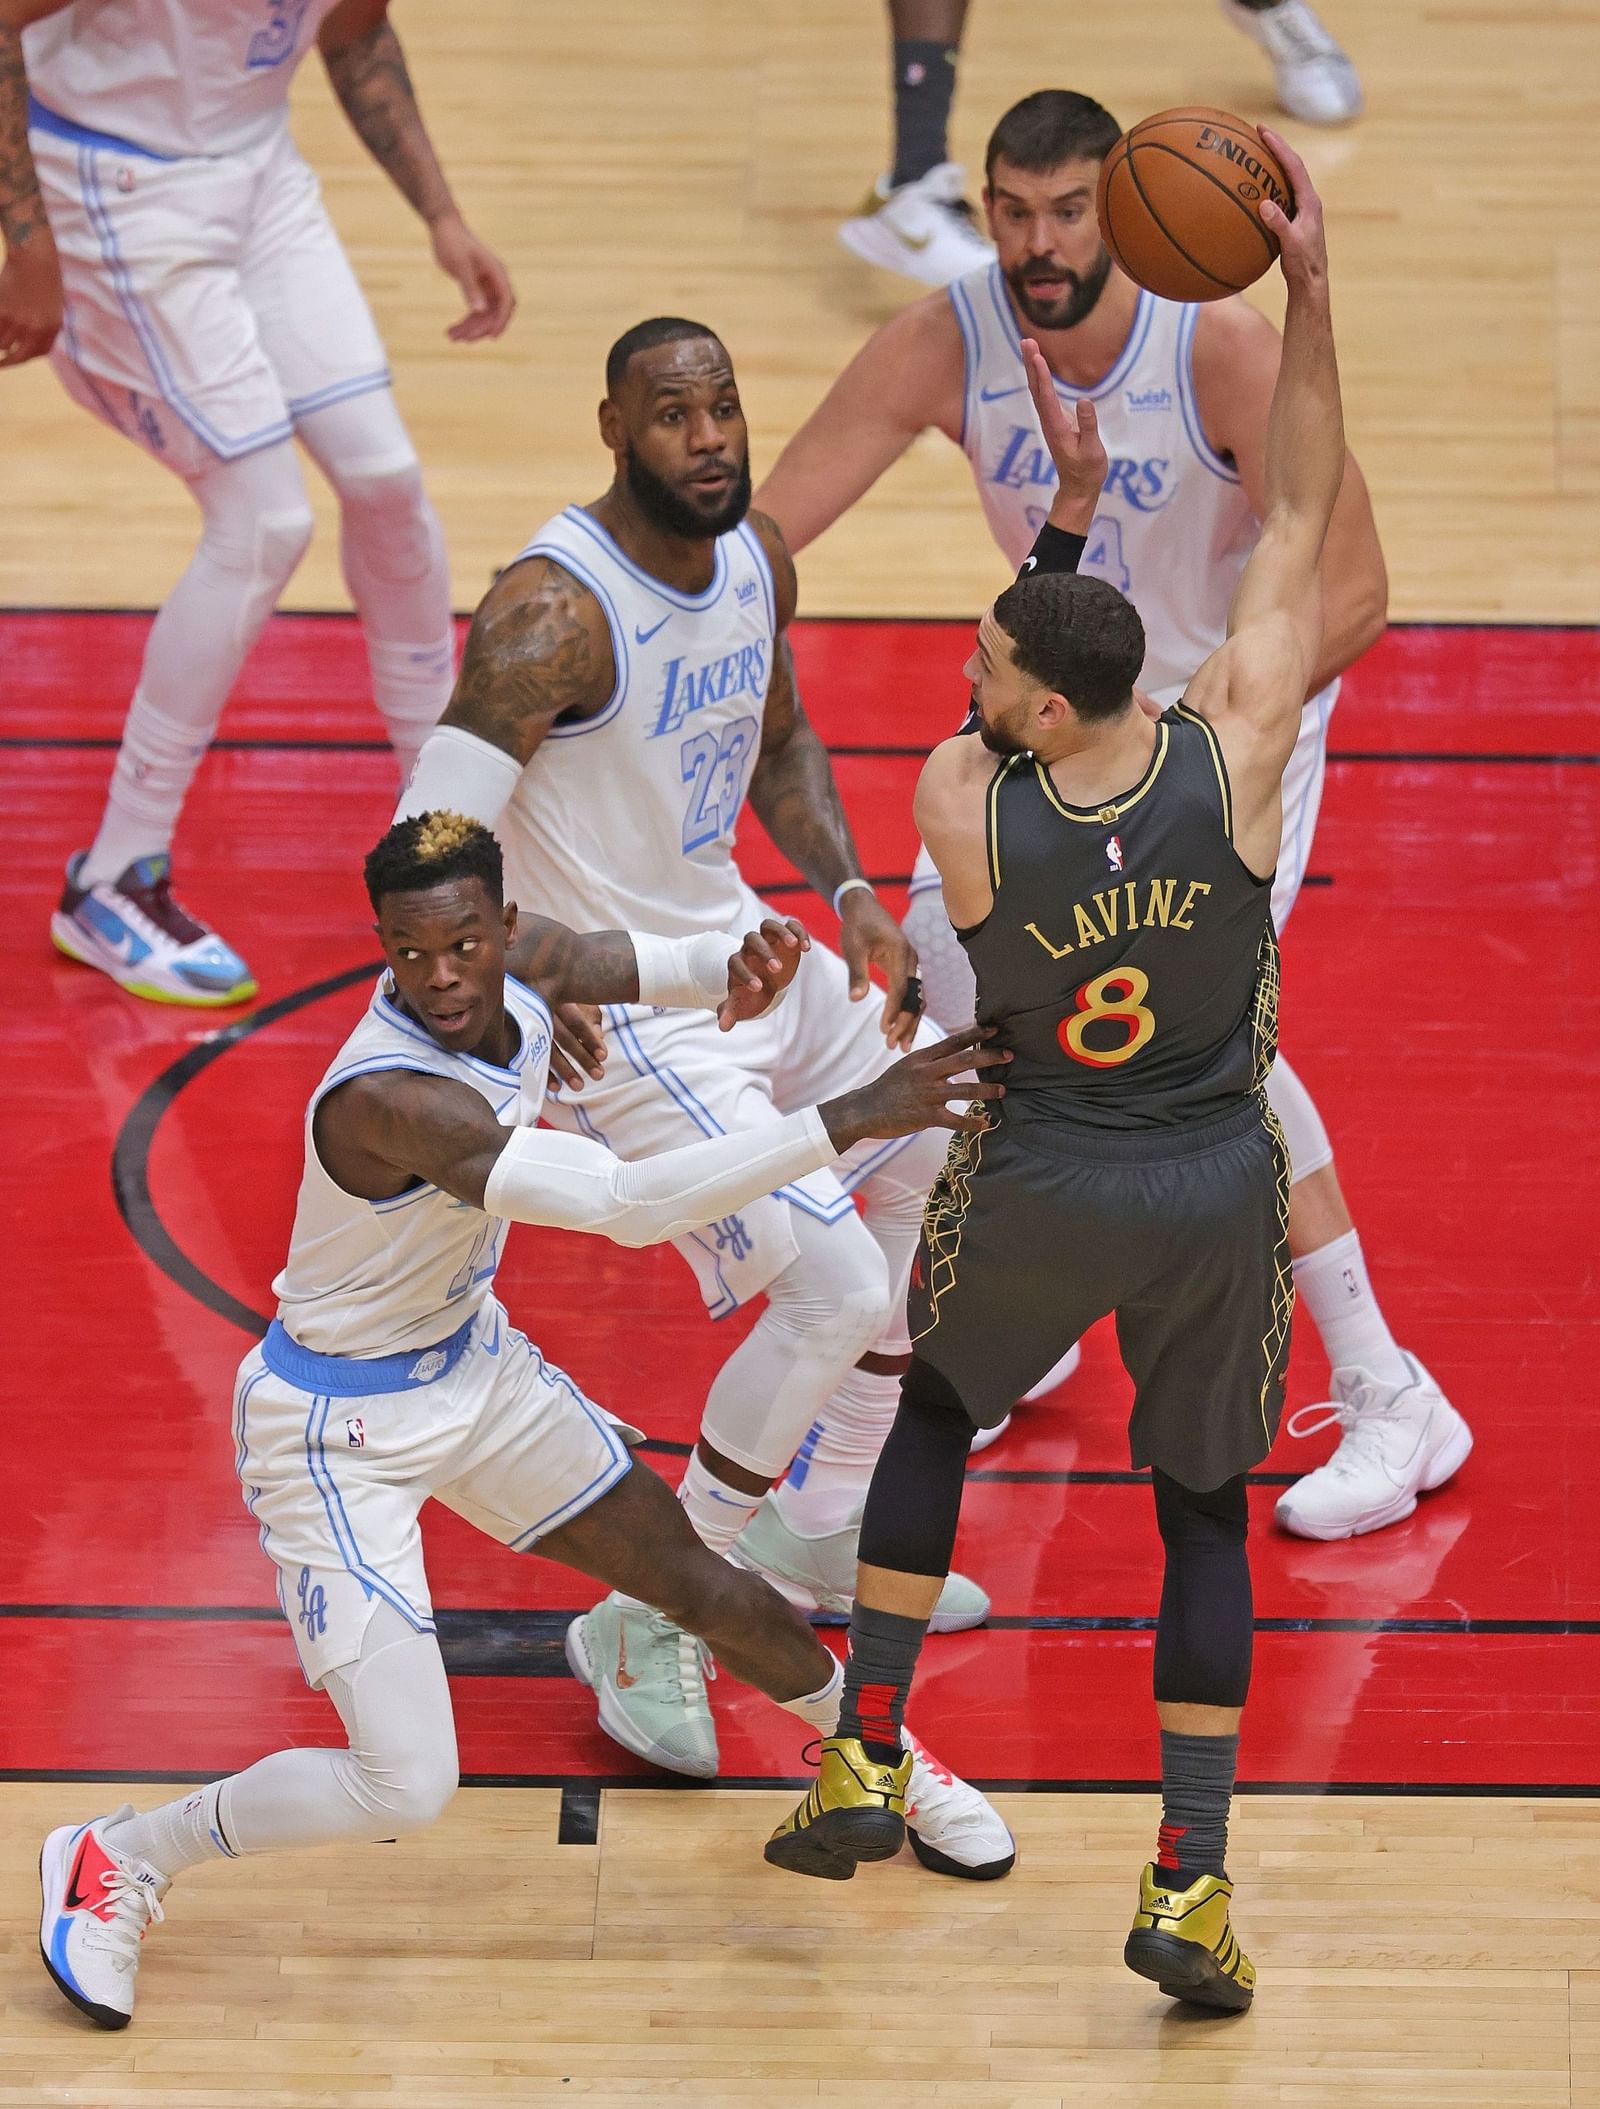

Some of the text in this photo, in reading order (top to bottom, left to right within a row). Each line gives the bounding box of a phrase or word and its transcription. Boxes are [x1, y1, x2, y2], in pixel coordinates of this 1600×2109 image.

[983, 423, 1179, 513] LARS
[1025, 505, 1131, 592] 4
[645, 638, 767, 741] LAKERS
[681, 715, 759, 856] 23
[1024, 879, 1211, 960] LAVINE
[530, 1033, 547, 1062] ish
[1057, 966, 1156, 1068] 8
[1148, 1902, 1174, 1913] adidas
